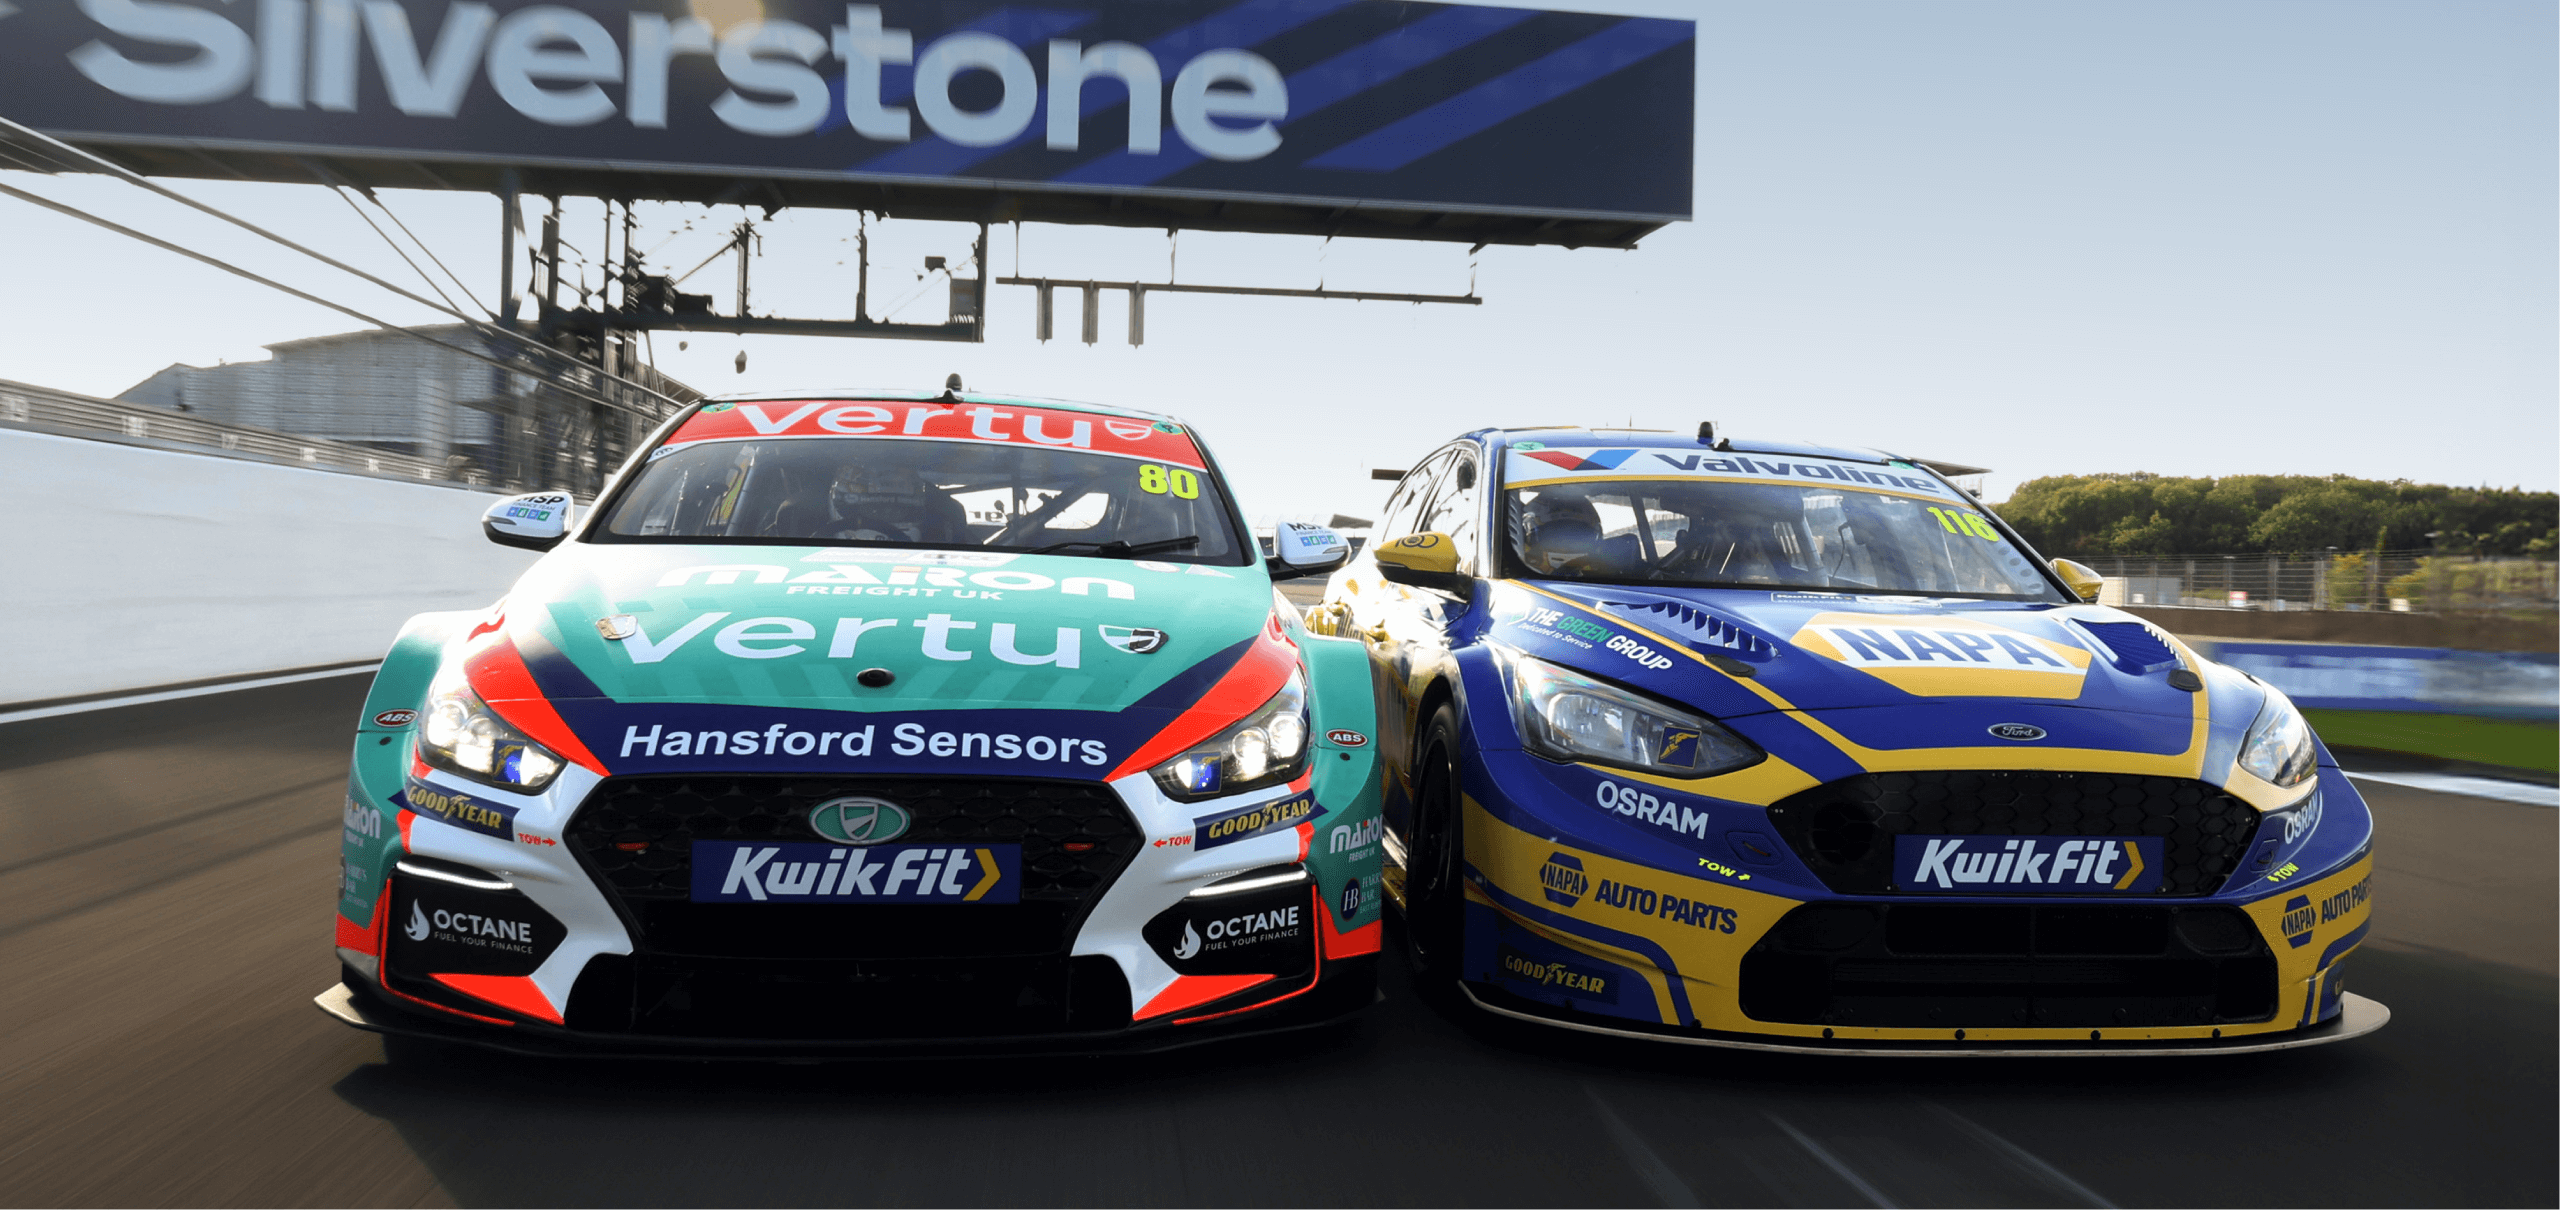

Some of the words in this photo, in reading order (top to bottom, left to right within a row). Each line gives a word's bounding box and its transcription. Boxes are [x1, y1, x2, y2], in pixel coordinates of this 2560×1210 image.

[66, 0, 1289, 162] Silverstone
[1138, 464, 1200, 500] 80
[1651, 453, 1941, 493] Valvoline
[1927, 506, 2000, 541] 116
[786, 585, 942, 598] FREIGHT
[952, 589, 1004, 601] UK
[1528, 606, 1565, 627] THE
[1556, 615, 1615, 643] GREEN
[1605, 634, 1673, 670] GROUP
[1560, 634, 1594, 650] Service
[1828, 627, 2068, 668] NAPA
[380, 712, 415, 723] ABS
[2002, 726, 2034, 737] Ford
[620, 723, 875, 758] Hansford
[891, 722, 1108, 767] Sensors
[1331, 731, 1362, 743] ABS
[1596, 780, 1709, 840] OSRAM
[2285, 791, 2318, 845] OSRAM
[518, 833, 542, 846] TOW
[1168, 835, 1192, 846] TOW
[1698, 858, 1736, 878] TOW
[2274, 862, 2299, 880] TOW
[1343, 888, 1359, 911] HB
[1545, 862, 1582, 895] NAPA
[1595, 879, 1656, 916] AUTO
[1659, 894, 1738, 935] PARTS
[2287, 906, 2313, 936] NAPA
[2321, 889, 2350, 925] AUTO
[434, 909, 533, 943] OCTANE
[1205, 940, 1228, 951] FUEL
[1232, 936, 1257, 947] YOUR
[1260, 928, 1300, 943] FINANCE
[1207, 906, 1300, 940] OCTANE
[434, 931, 457, 942] FUEL
[461, 935, 487, 947] YOUR
[491, 940, 534, 955] FINANCE
